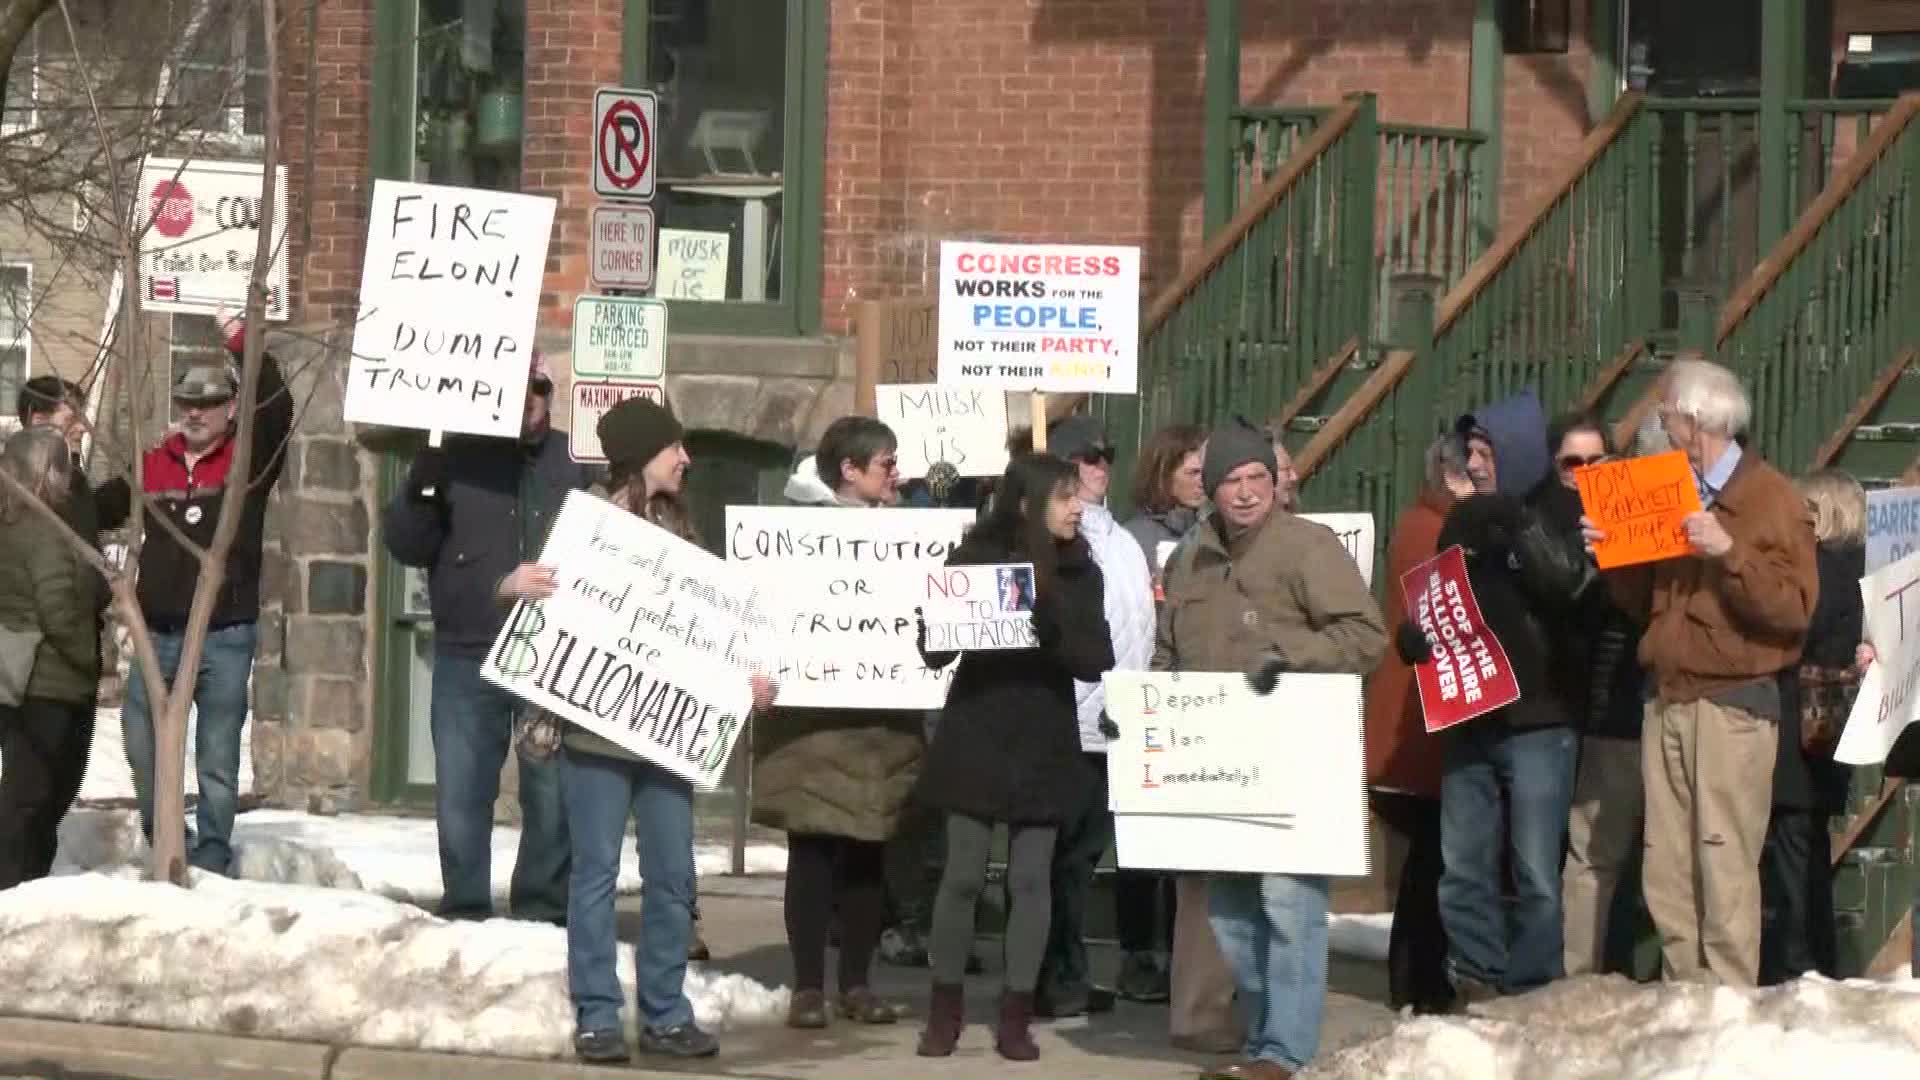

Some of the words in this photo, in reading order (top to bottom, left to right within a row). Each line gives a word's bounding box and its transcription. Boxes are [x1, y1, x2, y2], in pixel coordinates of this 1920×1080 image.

[216, 195, 263, 230] COU
[392, 194, 509, 240] FIRE
[600, 221, 627, 244] HERE
[633, 222, 645, 244] TO
[600, 249, 643, 272] CORNER
[668, 237, 722, 264] MUSK
[956, 252, 1121, 276] CONGRESS
[391, 250, 520, 298] ELON!
[955, 279, 1046, 298] WORKS
[1052, 289, 1076, 300] FOR
[1080, 290, 1103, 300] THE
[594, 304, 645, 326] PARKING
[973, 303, 1102, 331] PEOPLE,
[393, 321, 517, 360] DUMP
[589, 327, 649, 348] ENFORCED
[954, 340, 985, 352] NOT
[991, 340, 1036, 353] THEIR
[1041, 337, 1119, 356] PARTY,
[961, 364, 993, 377] NOT
[999, 365, 1044, 377] THEIR
[364, 367, 503, 421] TRUMP!
[580, 388, 623, 408] MAXIMUM
[900, 389, 984, 419] MUSK
[924, 437, 966, 465] US
[1574, 463, 1635, 507] TOM
[572, 577, 633, 614] need
[829, 578, 873, 596] OR
[927, 570, 970, 600] NO
[965, 600, 994, 620] TO
[1445, 579, 1473, 635] STOP
[617, 637, 661, 663] are
[1429, 571, 1483, 704] BILLIONAIRE
[768, 656, 841, 681] HICH
[1470, 636, 1498, 680] THE
[1141, 683, 1228, 712] Deport
[1144, 727, 1206, 748] Elon
